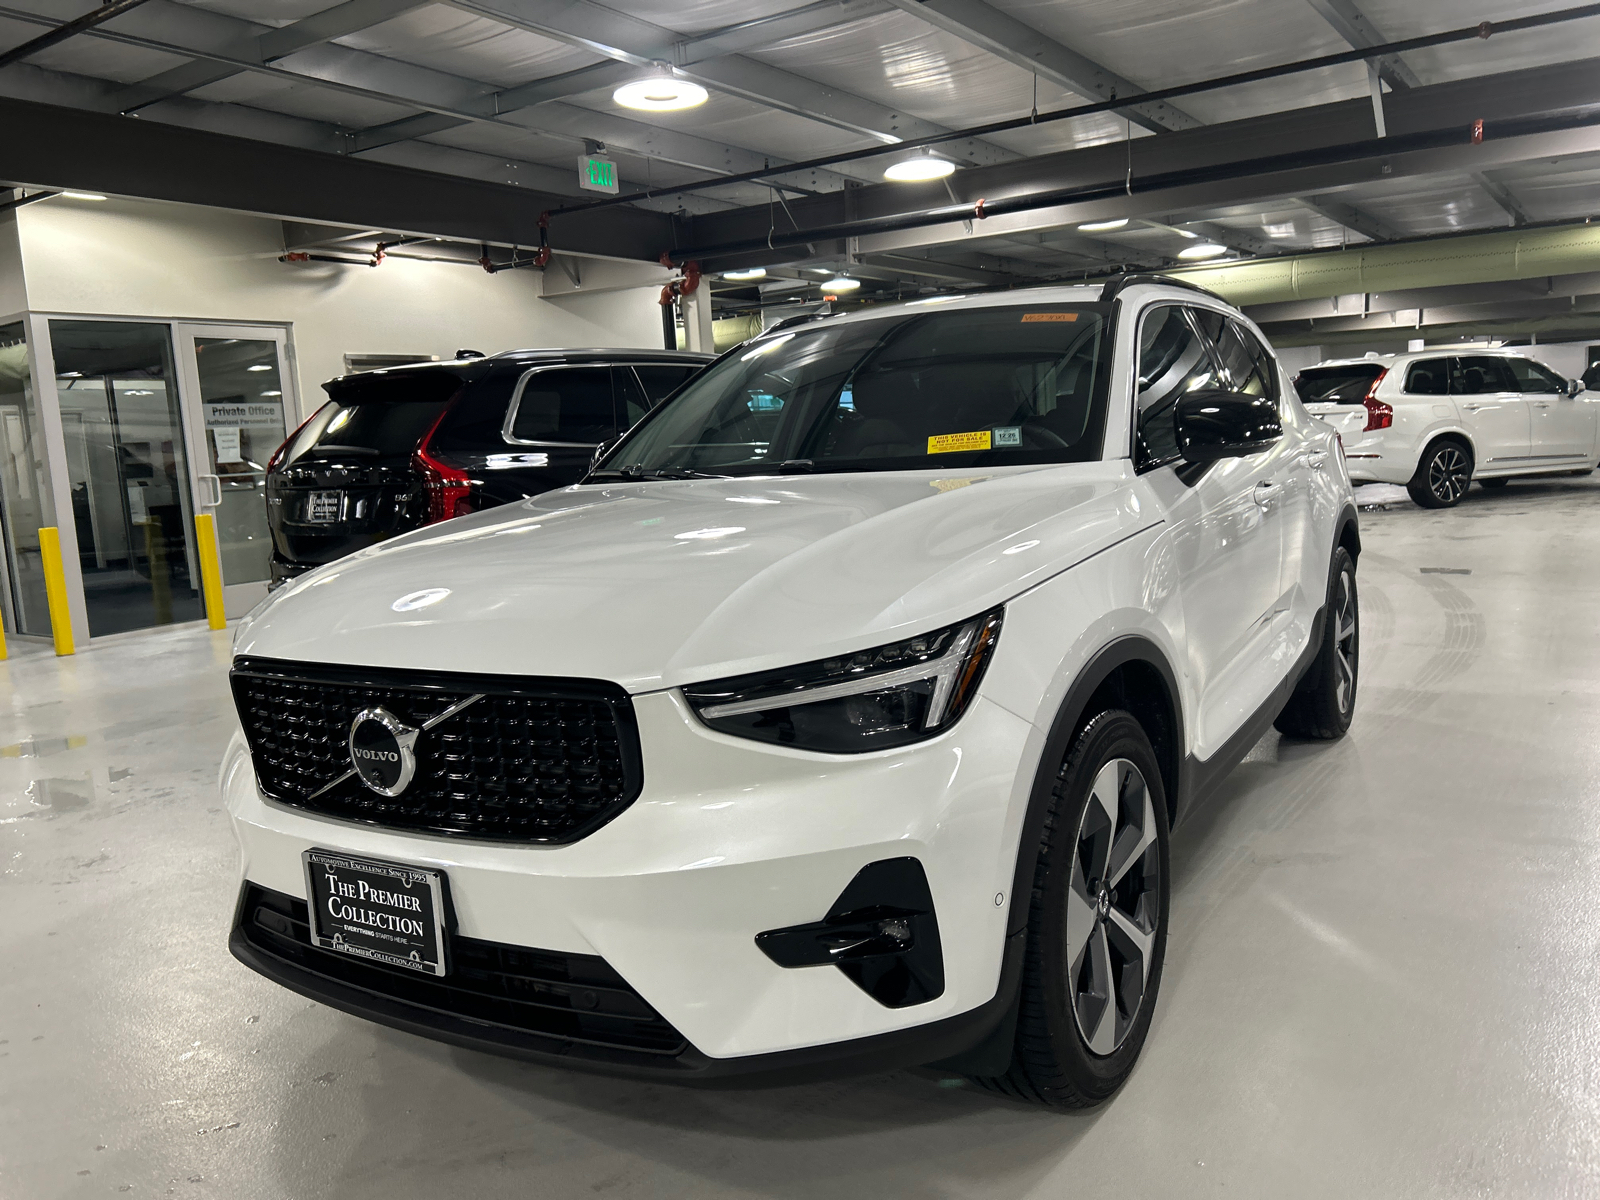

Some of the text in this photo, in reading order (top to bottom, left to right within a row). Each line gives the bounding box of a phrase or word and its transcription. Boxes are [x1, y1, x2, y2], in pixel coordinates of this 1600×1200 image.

[589, 159, 612, 187] EXIT
[212, 406, 275, 416] Private Office
[353, 747, 399, 762] VOLVO
[311, 855, 427, 882] AUTOMOTIVE EXCELLENCE SINCE 1995
[325, 873, 422, 912] THE PREMIER
[327, 896, 424, 937] COLLECTION
[343, 924, 375, 937] EVERYTHING
[375, 931, 394, 942] STARTS
